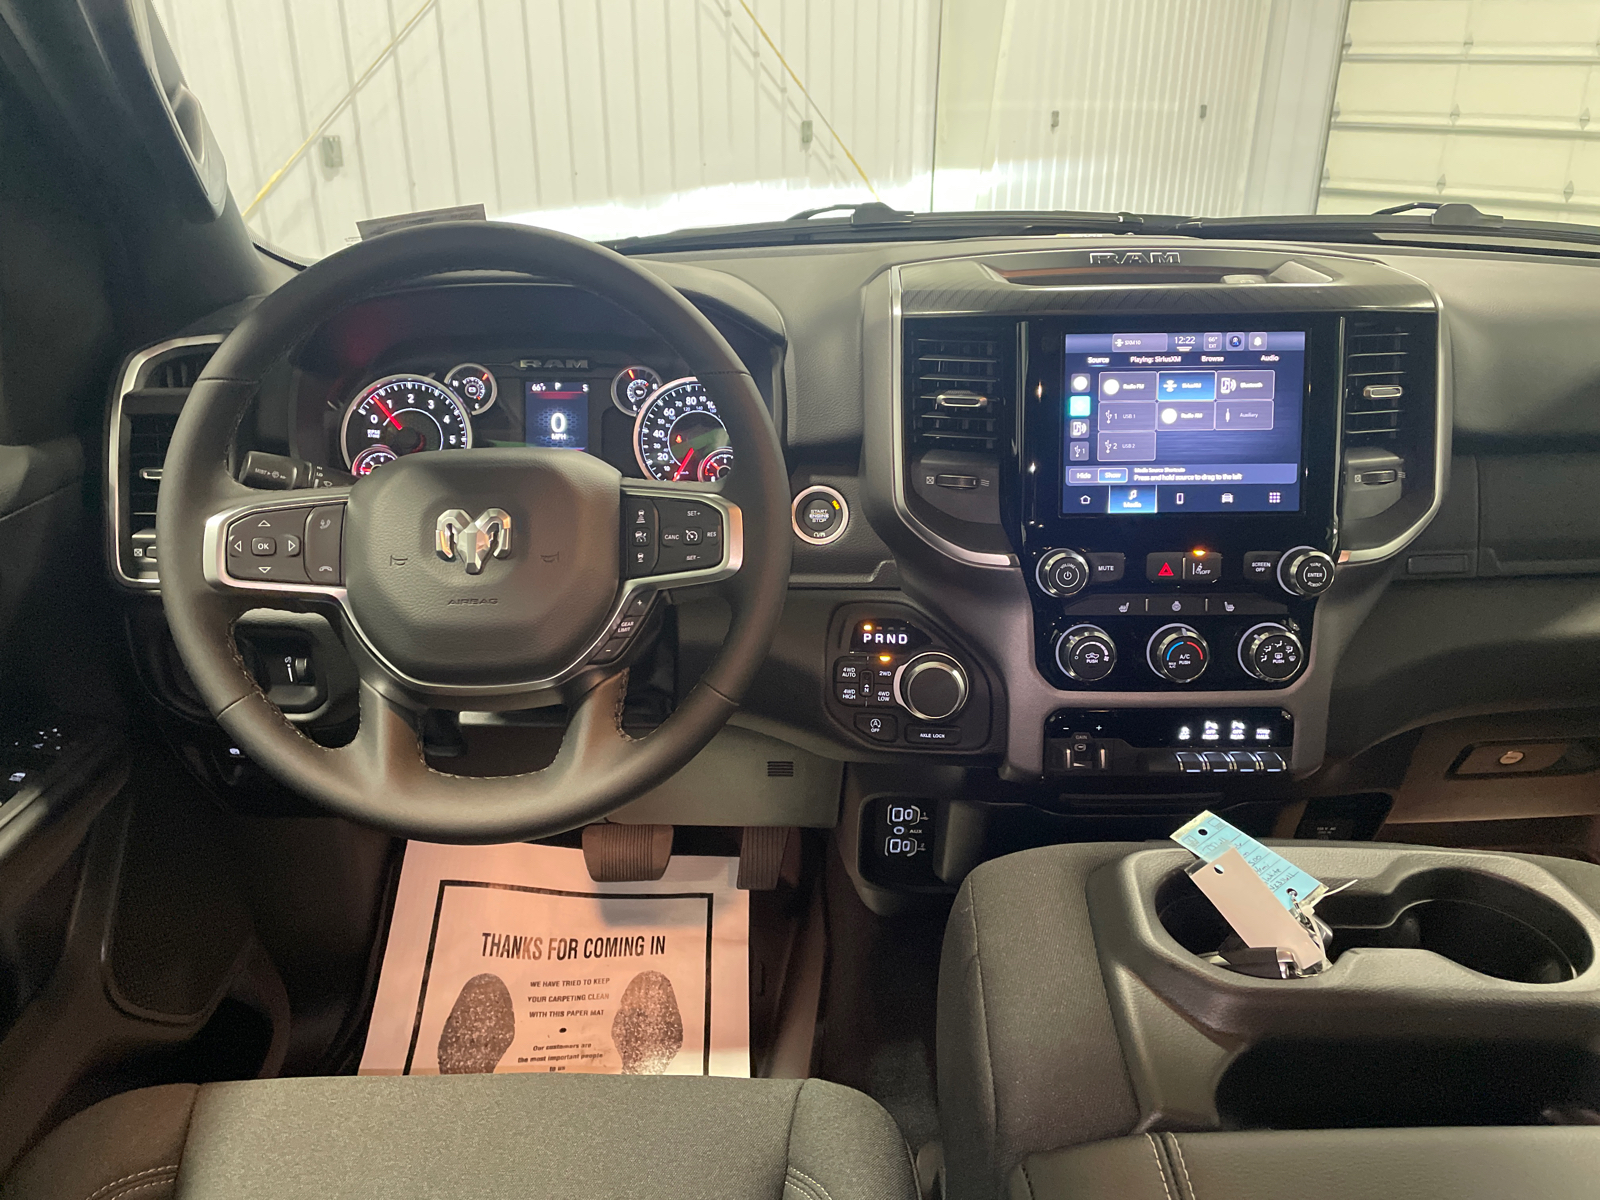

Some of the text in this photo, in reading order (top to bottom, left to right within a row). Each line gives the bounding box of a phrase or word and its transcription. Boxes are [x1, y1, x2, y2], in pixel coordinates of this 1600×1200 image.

[1090, 252, 1180, 264] RAM
[520, 360, 588, 368] RAM
[555, 382, 561, 391] P
[582, 384, 589, 392] S
[407, 394, 414, 403] 2
[686, 397, 697, 405] 80
[386, 400, 392, 408] 1
[428, 400, 435, 409] 3
[663, 408, 675, 416] 60
[370, 415, 378, 423] 0
[444, 415, 450, 423] 4
[550, 412, 567, 433] 0
[449, 435, 456, 444] 5
[657, 453, 668, 461] 20
[481, 932, 665, 960] THANKS FOR COMING IN
